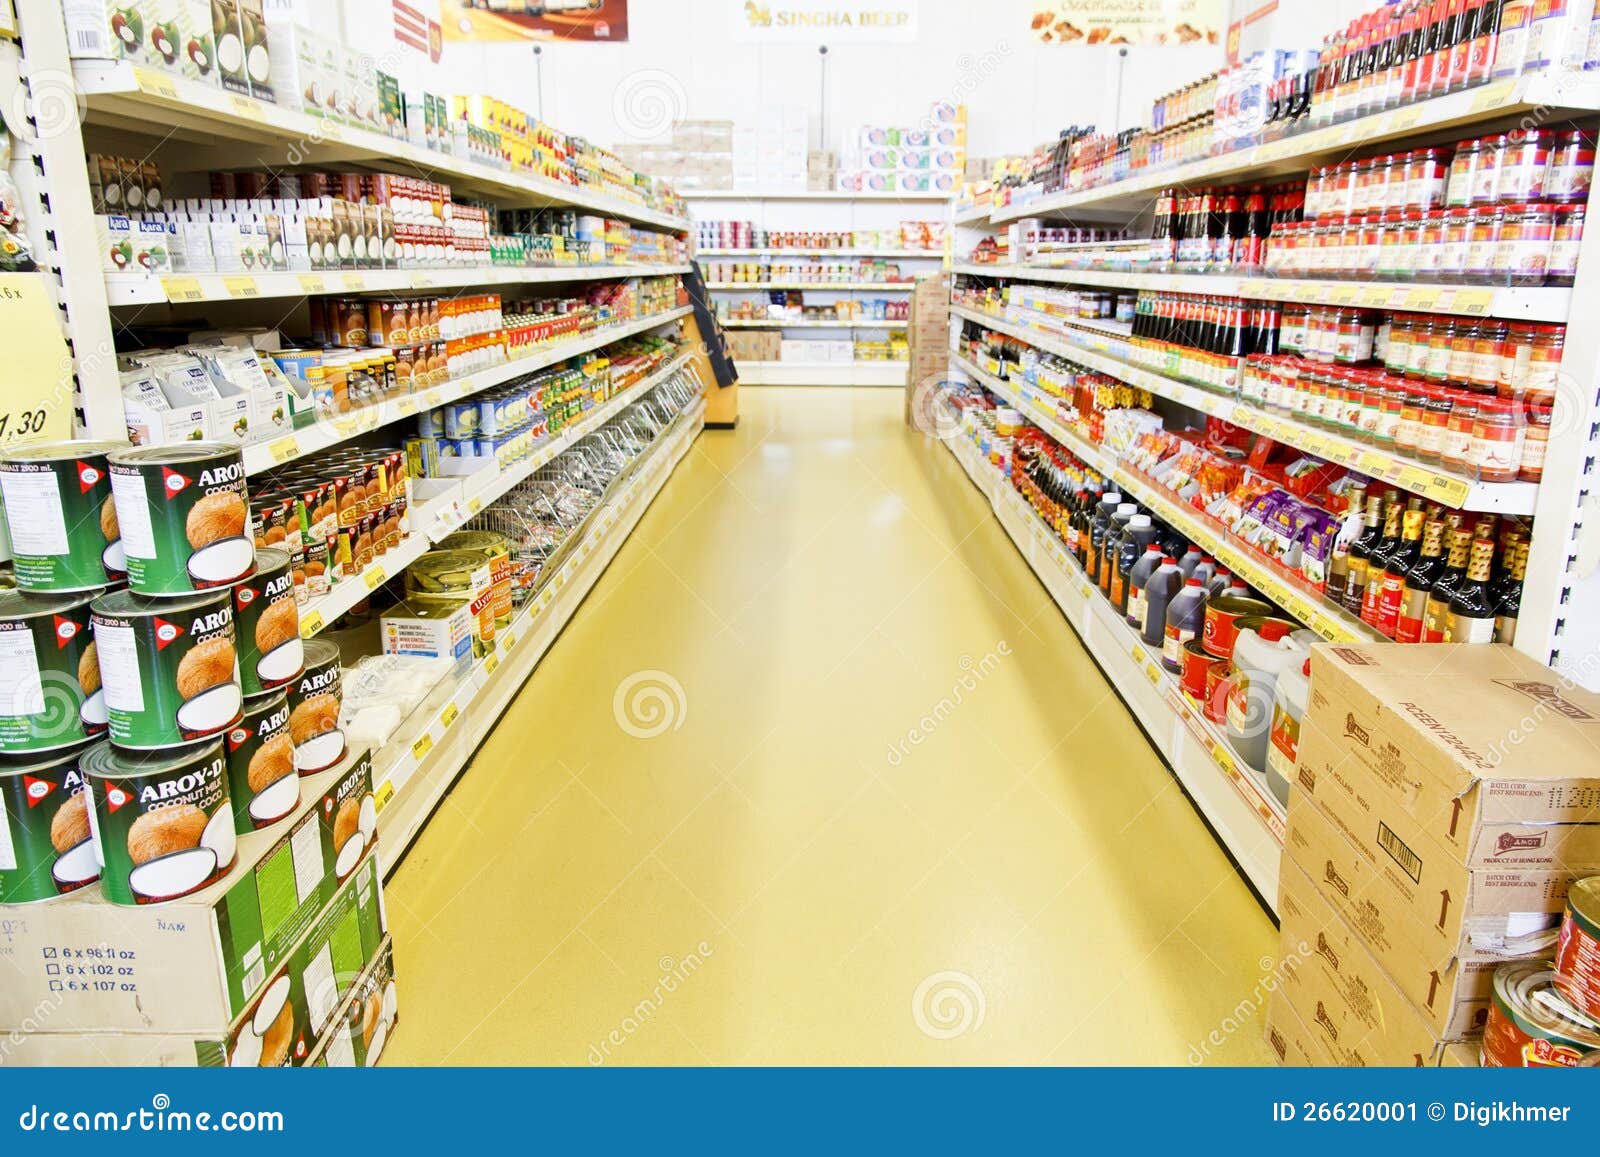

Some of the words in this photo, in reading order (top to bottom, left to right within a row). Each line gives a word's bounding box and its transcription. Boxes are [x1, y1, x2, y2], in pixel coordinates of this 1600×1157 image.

[777, 11, 852, 26] SINGHA
[859, 11, 910, 26] BEER
[139, 757, 223, 803] AROY-D
[147, 787, 205, 812] COCONUT
[204, 777, 223, 796] MILK
[199, 789, 223, 809] COCO
[1514, 838, 1539, 846] AMOY
[63, 948, 71, 958] 6
[75, 949, 83, 958] x
[119, 951, 136, 960] oz
[66, 964, 74, 975] 6
[78, 966, 86, 975] x
[90, 965, 114, 975] 102
[118, 967, 134, 976] oz
[68, 981, 77, 991] 6
[81, 982, 89, 991] x
[93, 981, 116, 991] 107
[120, 983, 137, 992] oz
